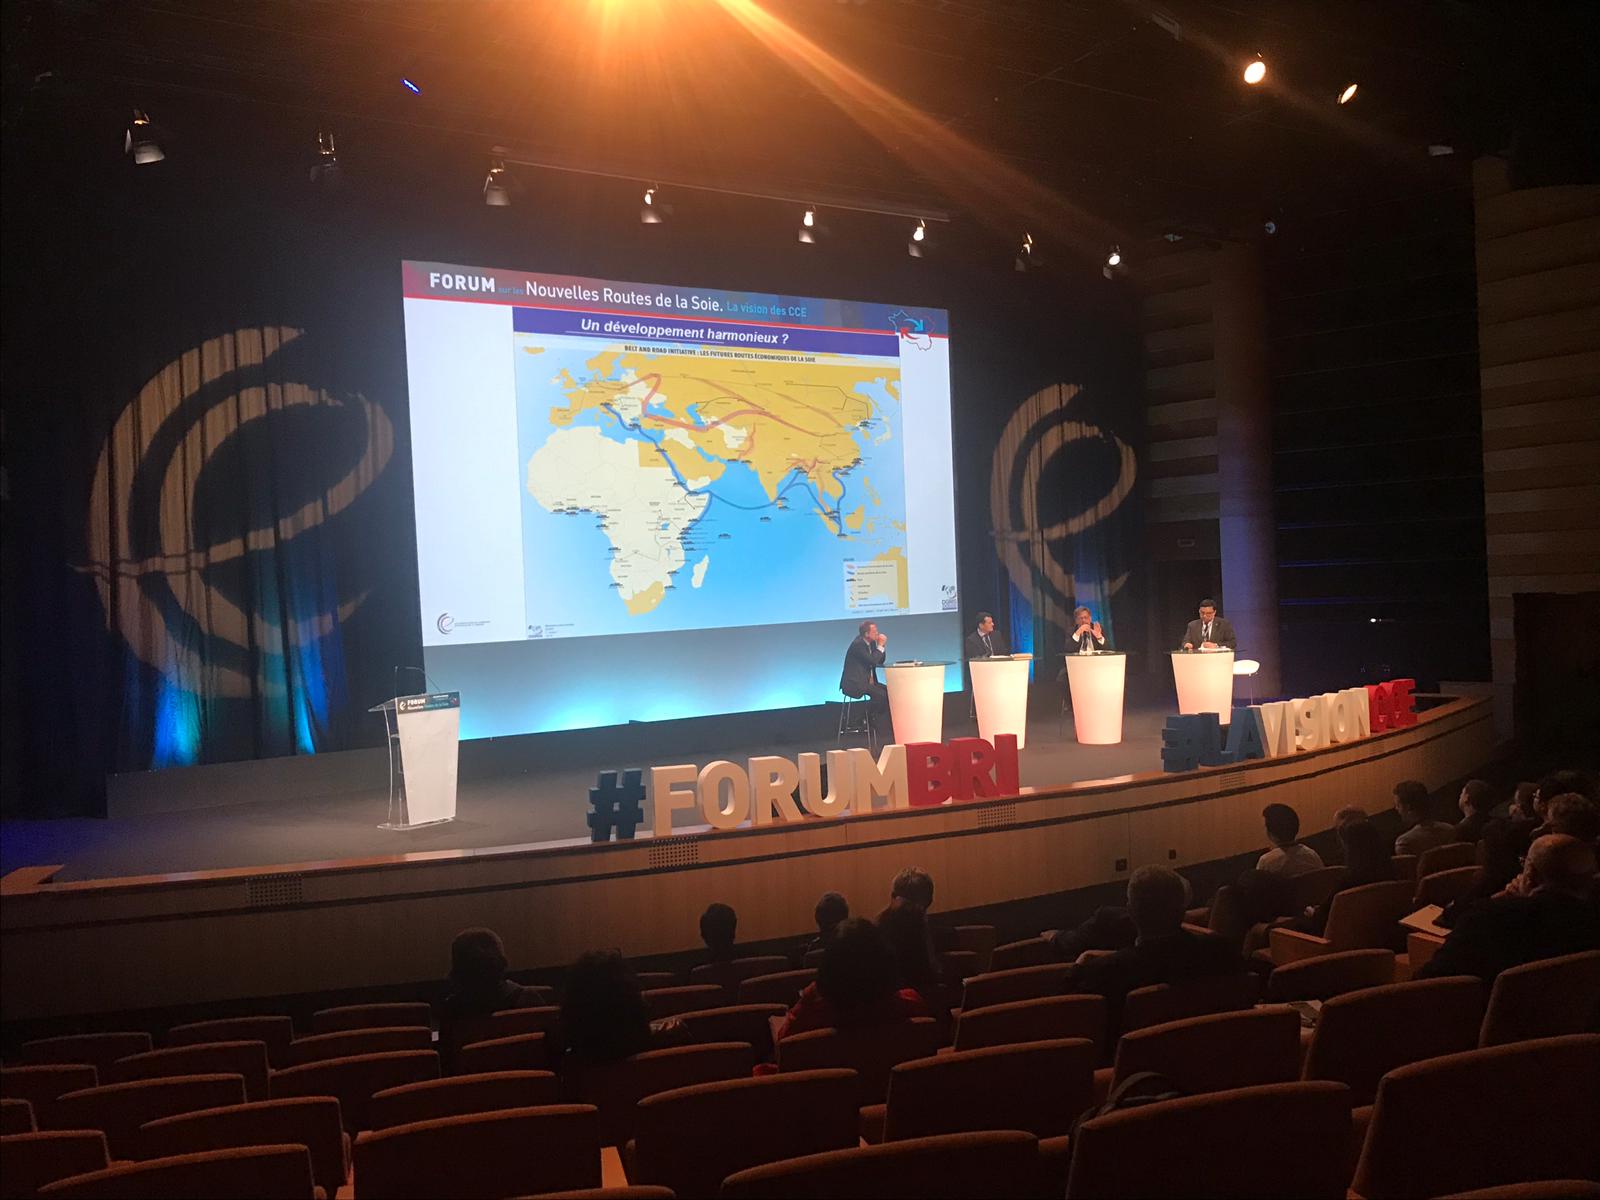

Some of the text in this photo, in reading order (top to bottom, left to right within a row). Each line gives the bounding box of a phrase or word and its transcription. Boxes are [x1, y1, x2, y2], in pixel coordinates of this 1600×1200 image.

[429, 272, 496, 293] FORUM
[526, 280, 600, 301] Nouvelles
[603, 288, 652, 306] Routes
[655, 293, 672, 307] de
[675, 294, 688, 309] la
[691, 295, 723, 312] Soie.
[727, 302, 738, 312] La
[740, 303, 768, 315] vision
[770, 304, 786, 316] des
[788, 306, 807, 317] CCE
[581, 318, 789, 344] Un développement harmonieux ?
[587, 733, 1020, 842] #FORUMBRI
